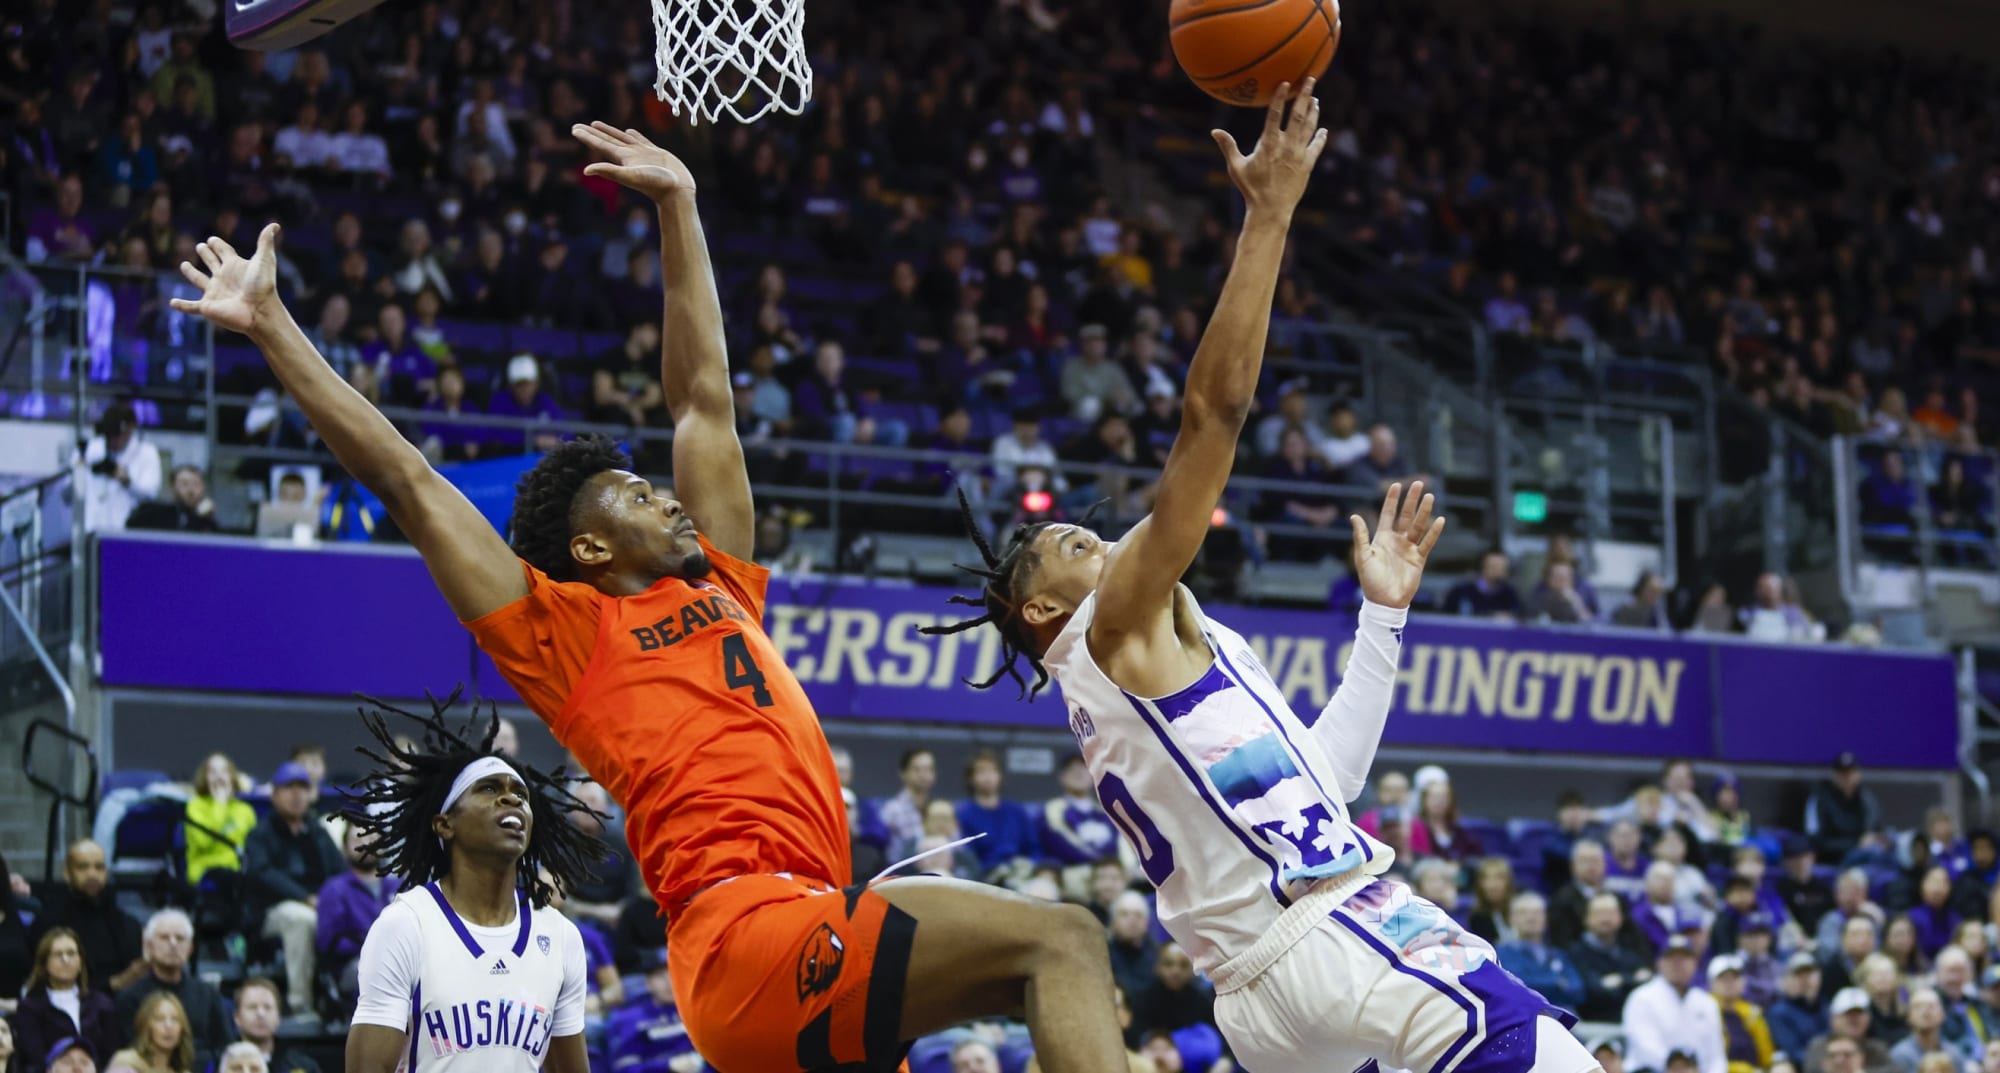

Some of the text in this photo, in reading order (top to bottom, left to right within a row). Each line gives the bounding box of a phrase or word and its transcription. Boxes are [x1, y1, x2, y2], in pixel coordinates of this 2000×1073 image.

[722, 632, 775, 708] 4
[767, 604, 1053, 694] ERSIT
[1097, 771, 1175, 887] 0
